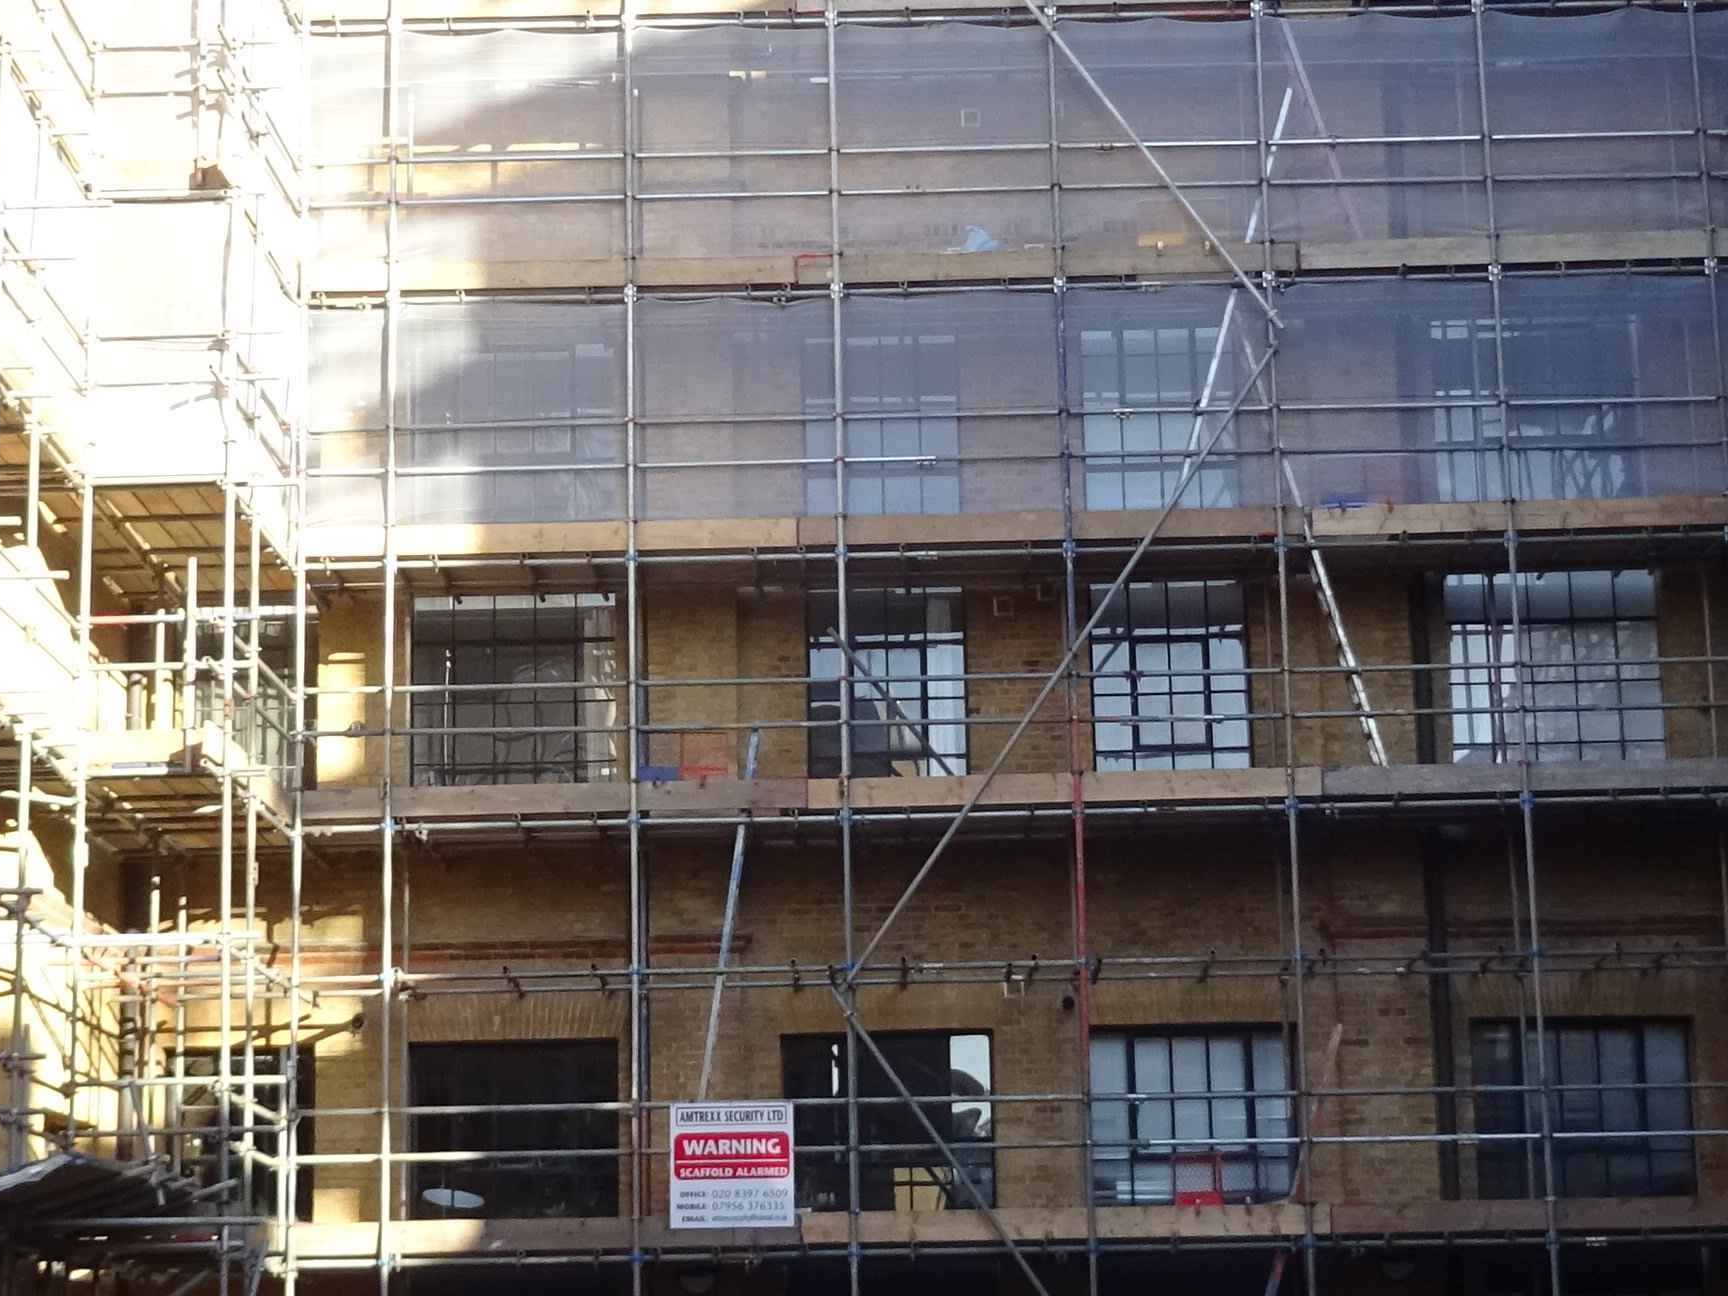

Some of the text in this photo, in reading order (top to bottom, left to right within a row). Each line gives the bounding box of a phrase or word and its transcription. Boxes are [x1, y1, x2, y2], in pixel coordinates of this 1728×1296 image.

[679, 1109, 784, 1123] AMTREXX SECURITY LTD
[682, 1138, 781, 1155] WARNING
[680, 1166, 788, 1178] SCAFFOLD ALARMED
[712, 1189, 731, 1198] 020
[734, 1189, 759, 1198] 8397
